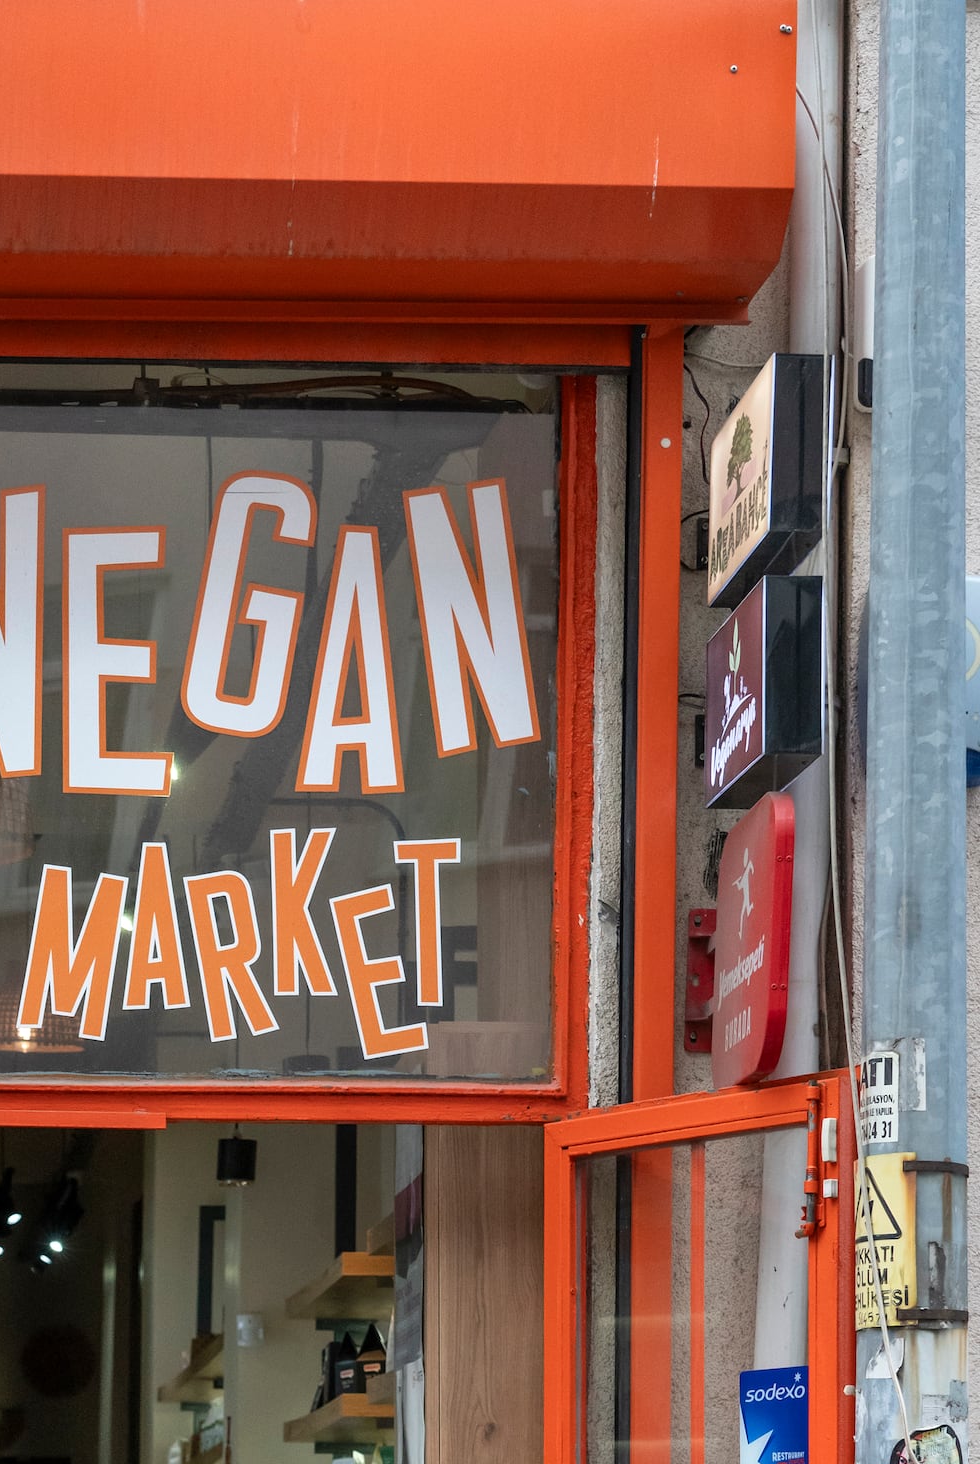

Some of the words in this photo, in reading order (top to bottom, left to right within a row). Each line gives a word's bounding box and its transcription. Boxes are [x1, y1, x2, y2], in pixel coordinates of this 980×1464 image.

[16, 827, 461, 1059] MARKET
[881, 1120, 892, 1138] 31
[745, 1383, 805, 1403] sodexo
